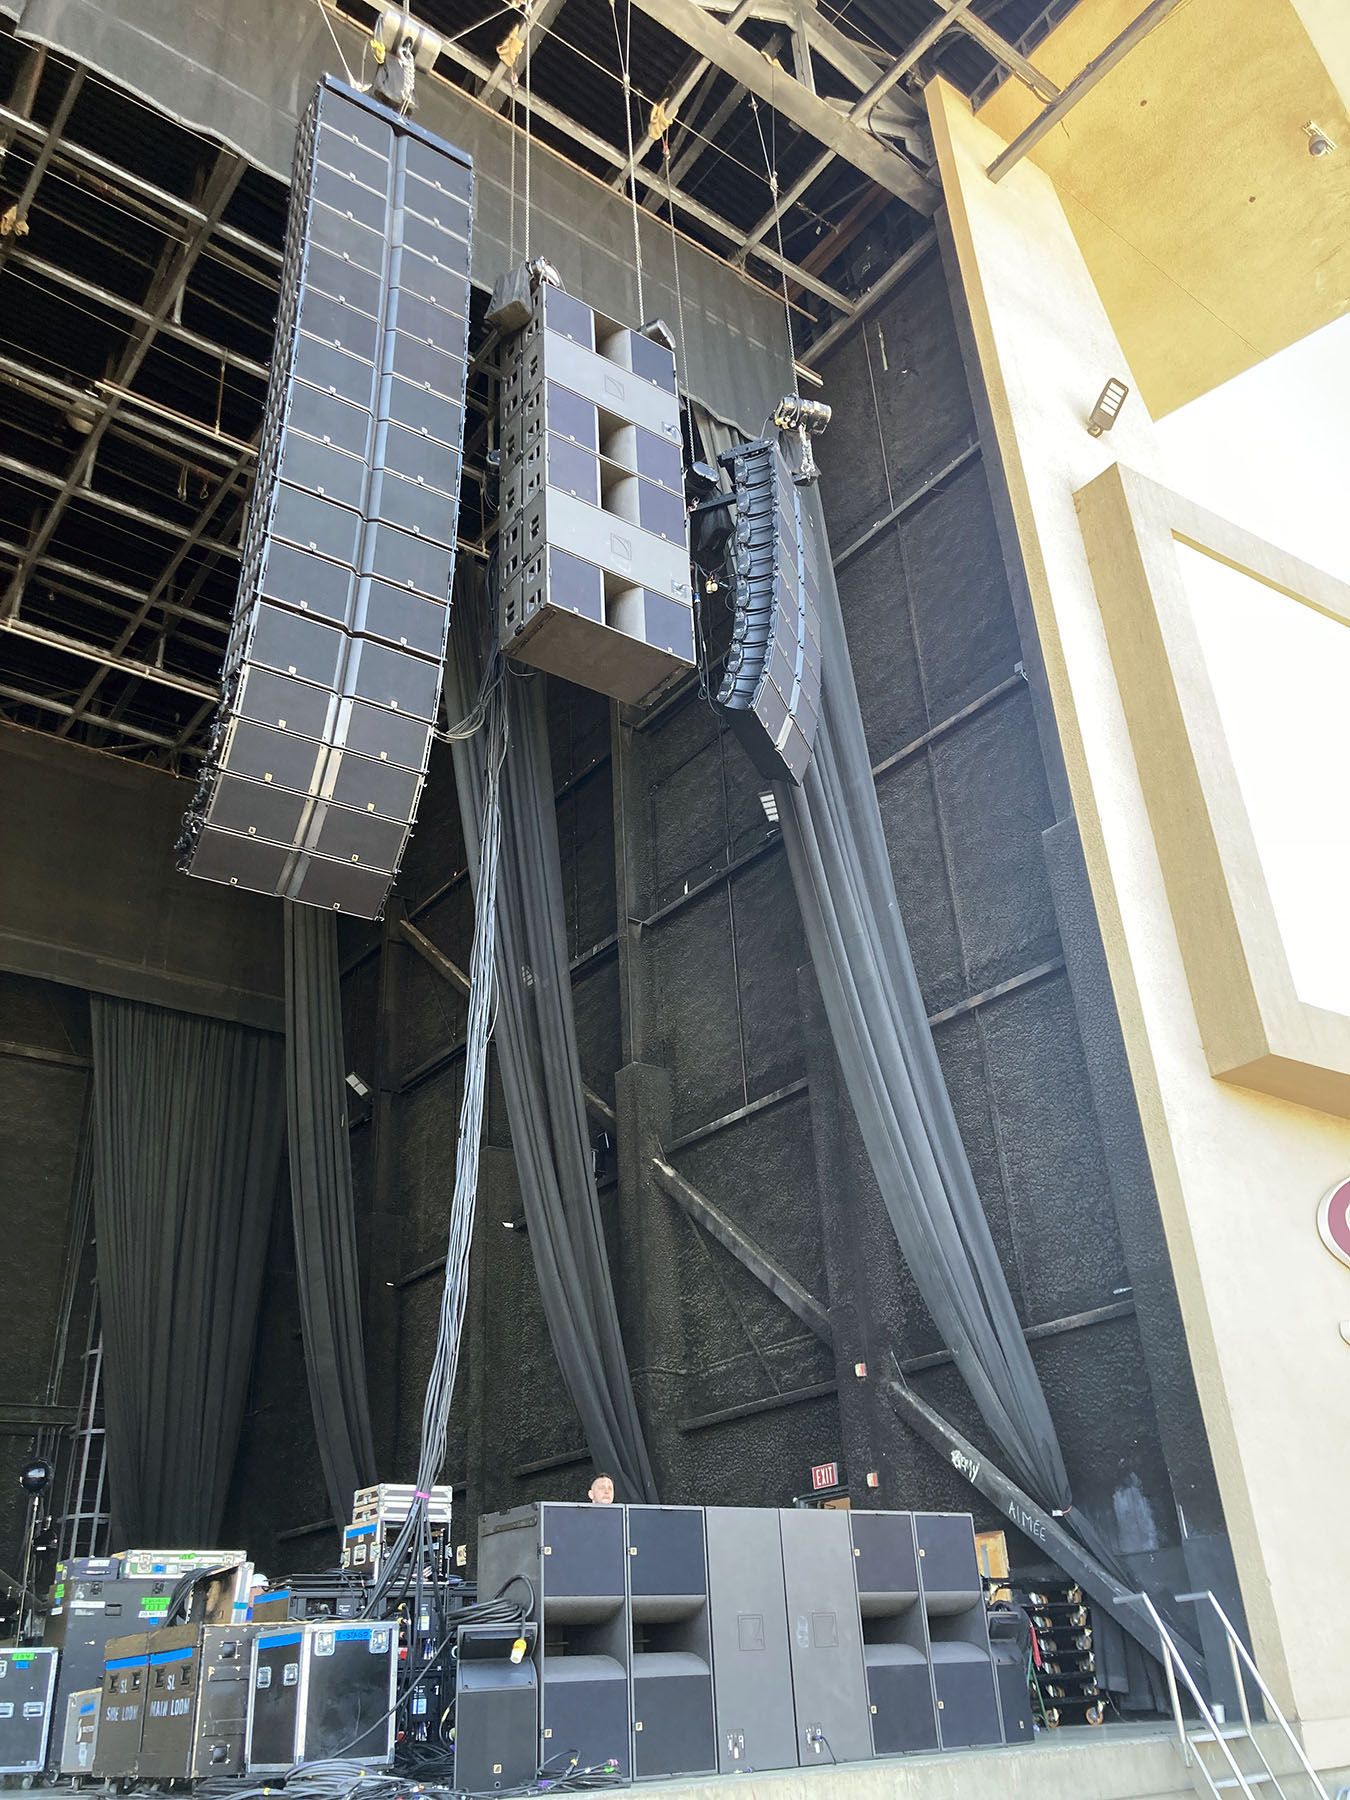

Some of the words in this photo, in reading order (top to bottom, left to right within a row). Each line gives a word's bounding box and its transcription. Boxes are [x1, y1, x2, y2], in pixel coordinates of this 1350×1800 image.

[815, 1466, 833, 1486] EXIT
[167, 1674, 176, 1690] SL
[149, 1700, 169, 1717] MAIN
[170, 1697, 191, 1716] LOOM
